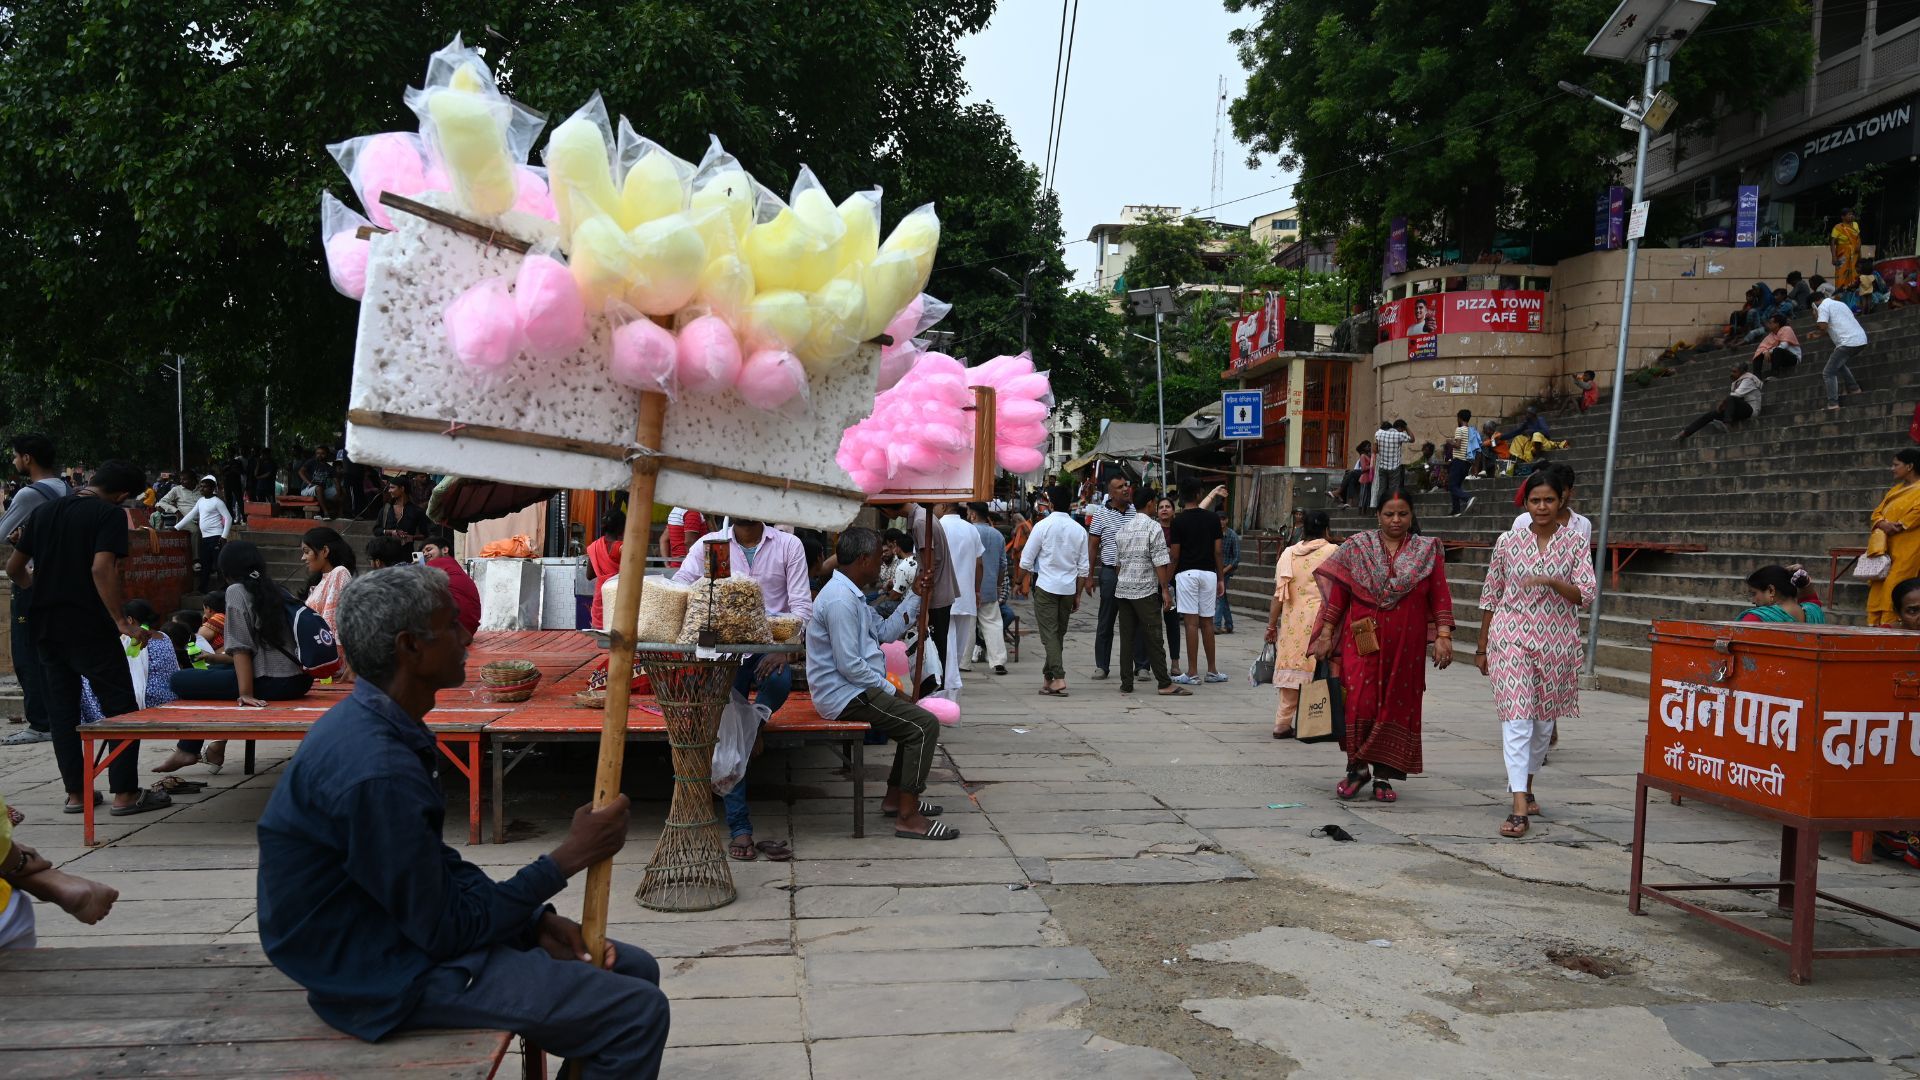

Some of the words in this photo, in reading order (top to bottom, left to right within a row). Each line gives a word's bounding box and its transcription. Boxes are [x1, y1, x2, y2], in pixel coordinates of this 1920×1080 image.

[1456, 298, 1497, 310] PIZZA
[1500, 298, 1540, 309] TOWN
[1481, 309, 1517, 323] CAFÉ
[1659, 678, 1729, 737] दान
[1732, 689, 1803, 752] पात्र
[1821, 711, 1904, 770] दान
[1687, 747, 1725, 781] गंगा
[1727, 762, 1785, 796] आरती
